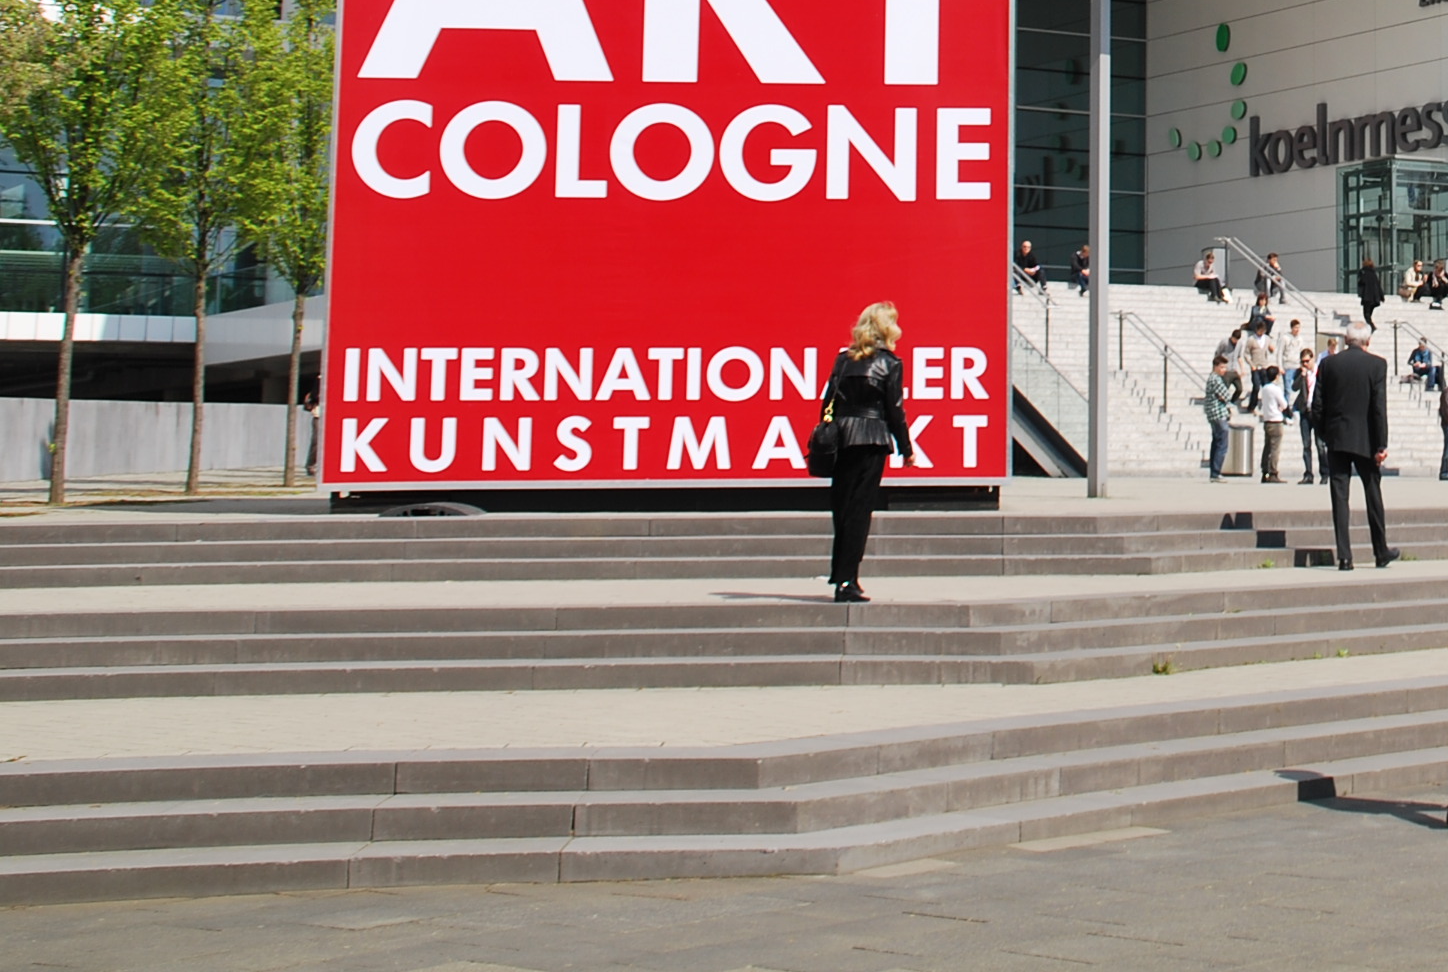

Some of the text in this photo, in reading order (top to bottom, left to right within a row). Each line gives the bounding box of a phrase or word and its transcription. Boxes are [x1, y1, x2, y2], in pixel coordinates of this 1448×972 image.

[351, 99, 992, 202] COLOGNE
[342, 346, 989, 402] INTERNATIONER
[339, 414, 988, 473] KUNSTMAKT
